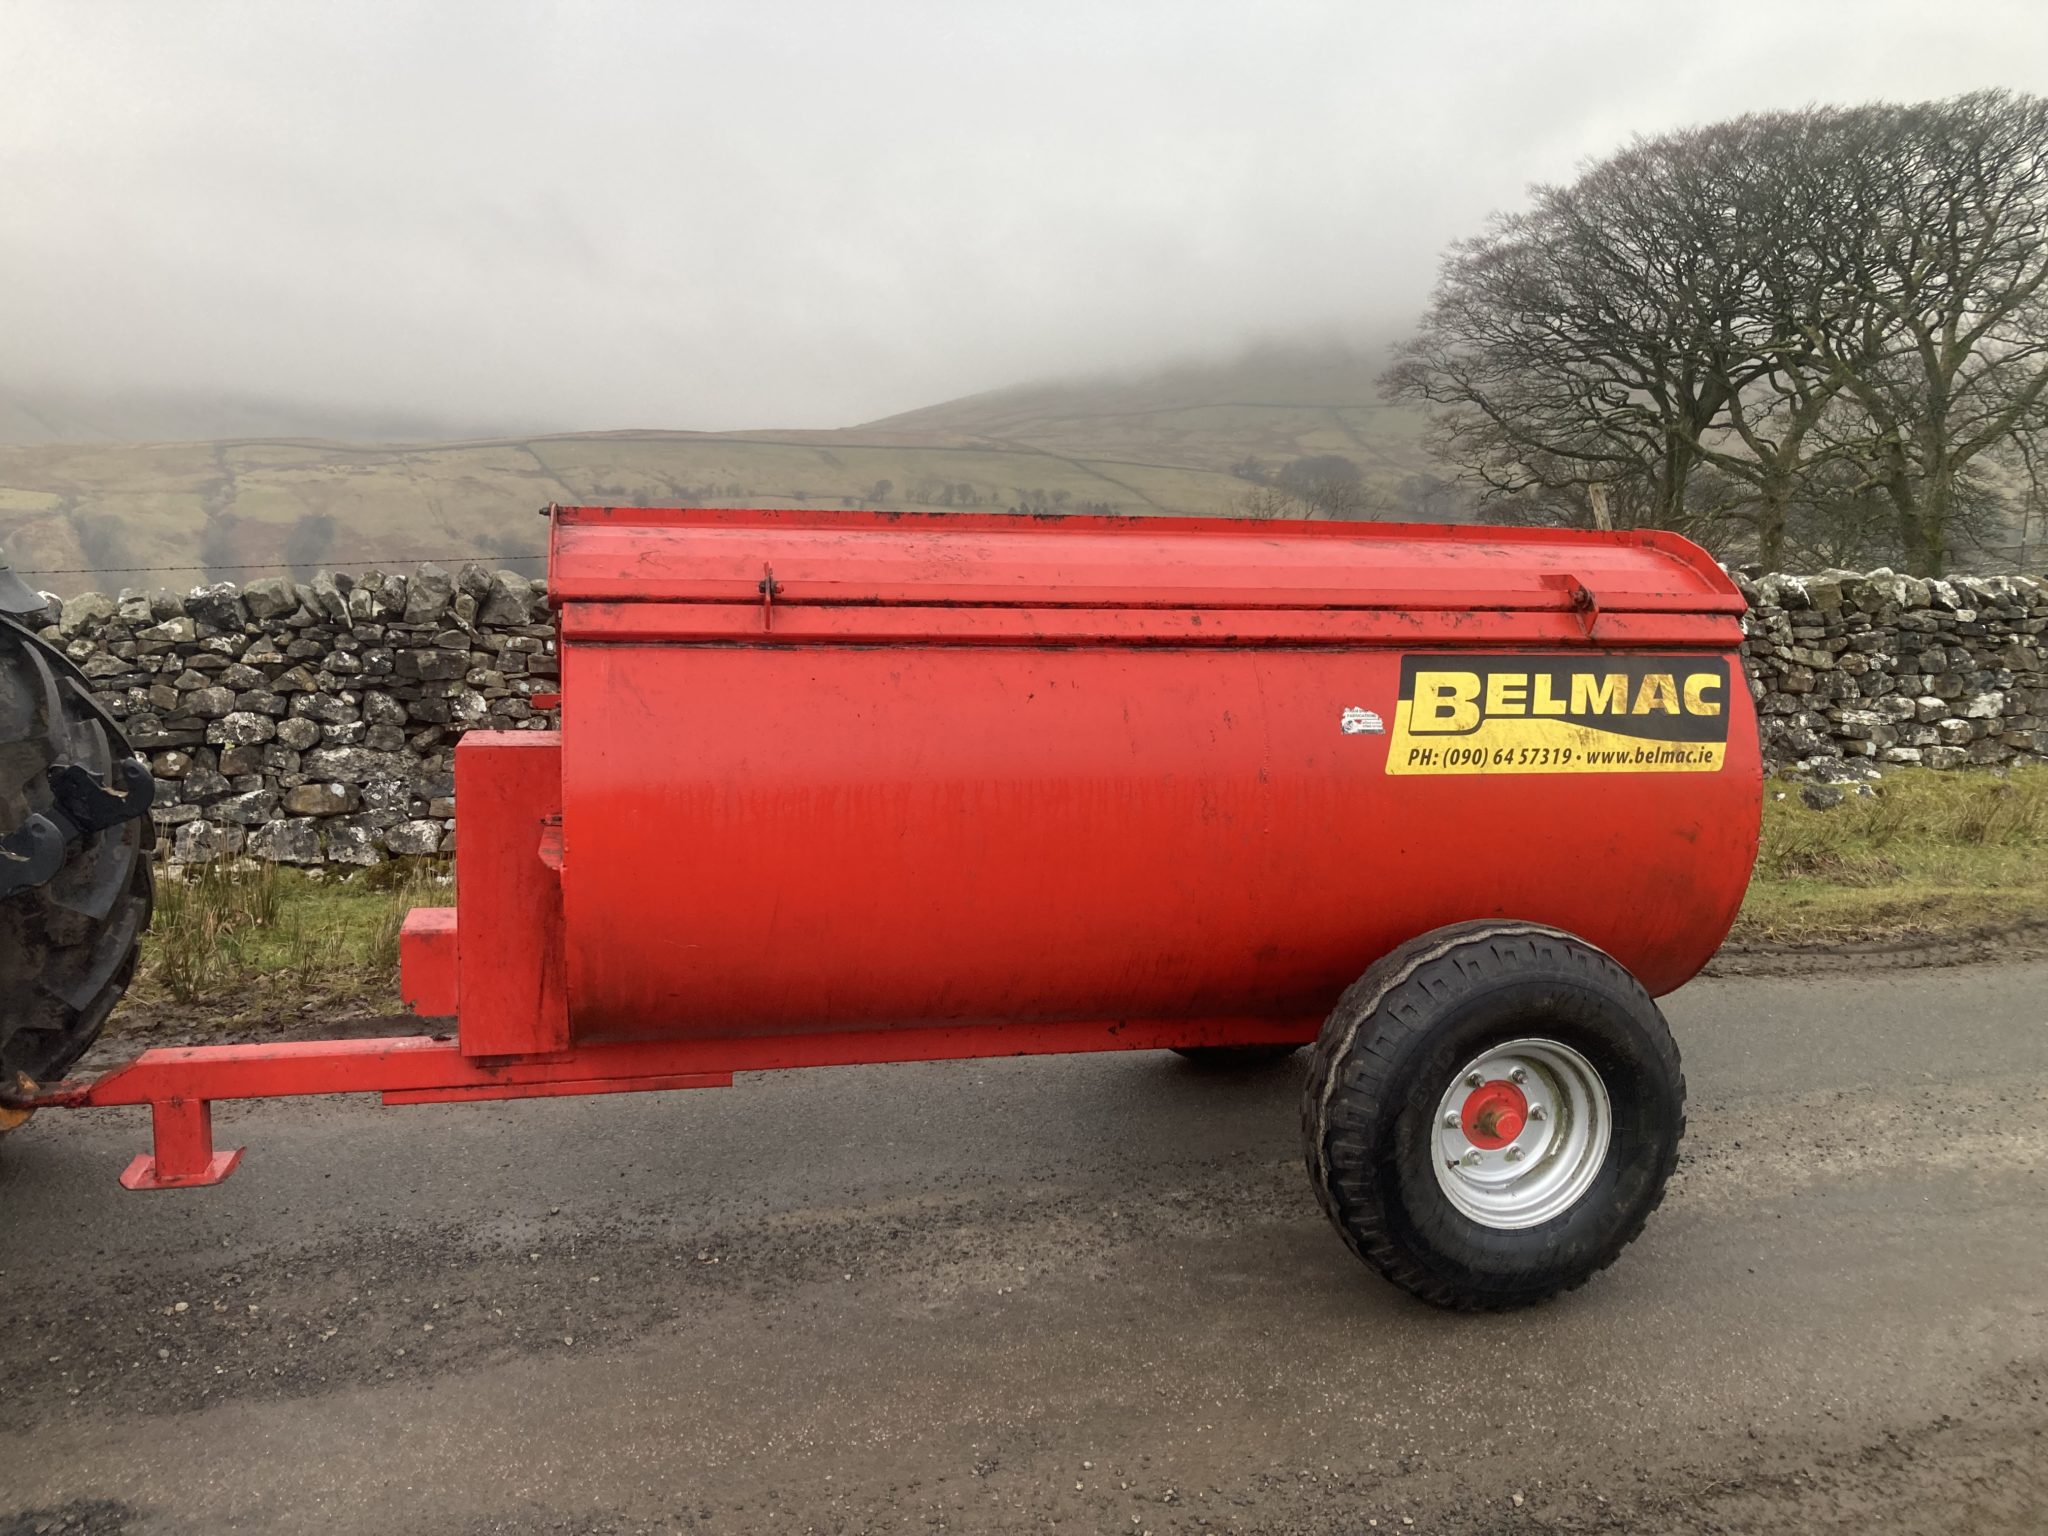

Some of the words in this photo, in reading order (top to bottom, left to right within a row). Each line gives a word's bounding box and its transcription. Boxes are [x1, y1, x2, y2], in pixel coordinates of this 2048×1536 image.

[1409, 671, 1721, 732] BELMAC
[1408, 748, 1439, 766] PH:
[1443, 747, 1489, 769] (090)
[1493, 748, 1514, 765] 64
[1518, 747, 1572, 765] 57319
[1587, 746, 1713, 764] www.belmac.ie
